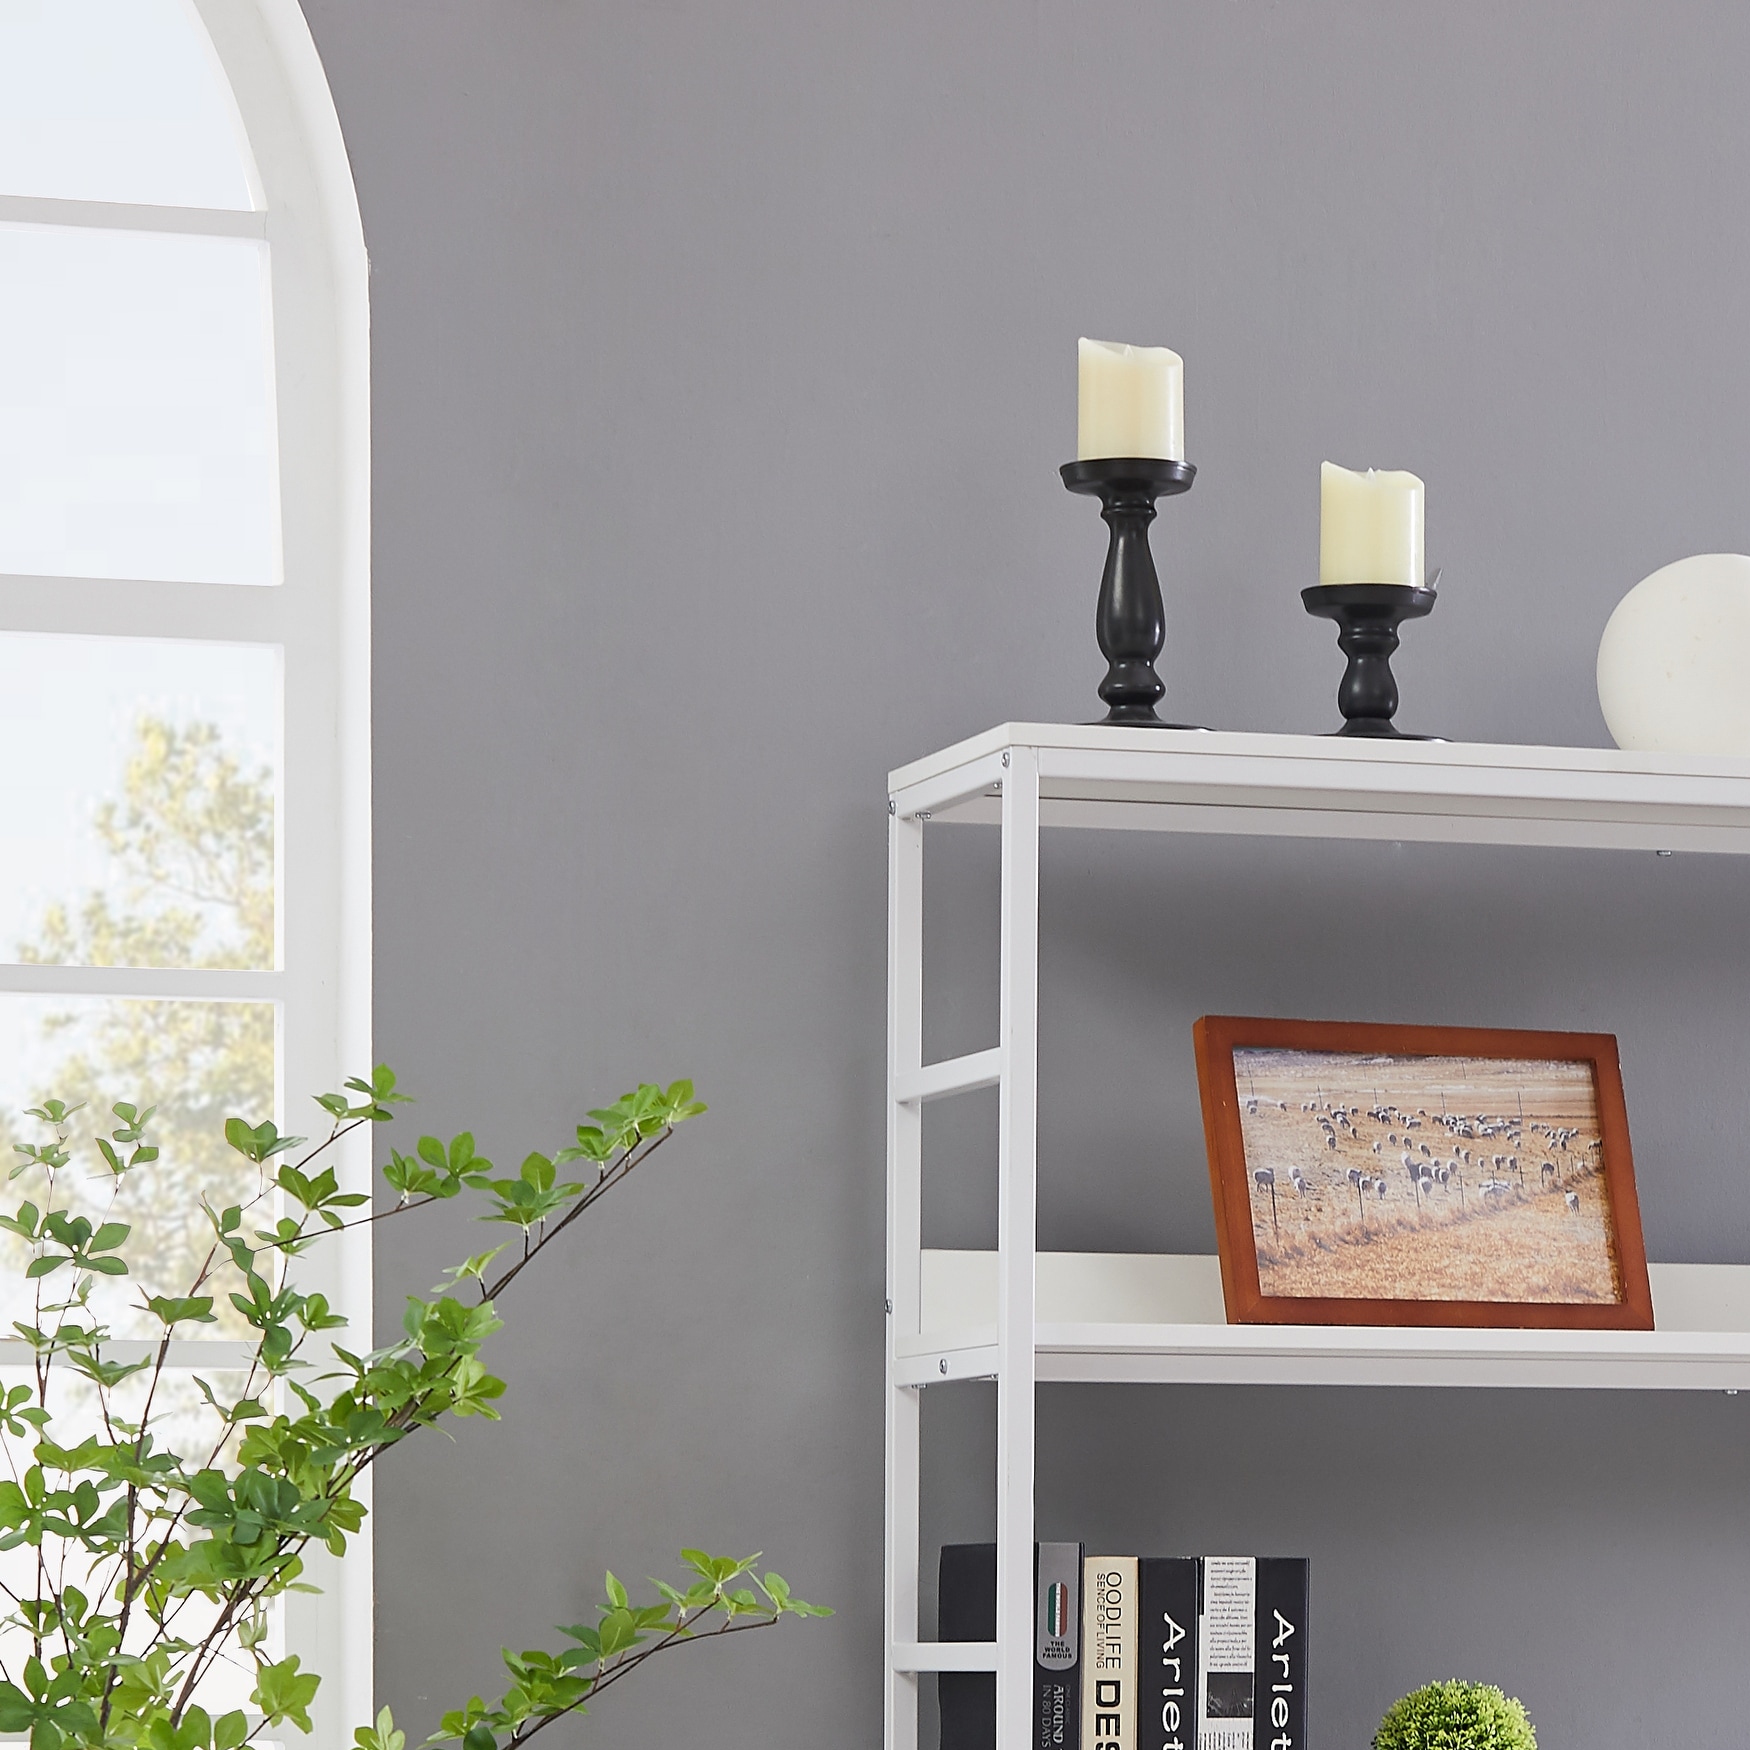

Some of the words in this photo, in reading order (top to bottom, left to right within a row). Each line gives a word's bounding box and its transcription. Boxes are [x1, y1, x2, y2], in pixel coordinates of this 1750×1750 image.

[1096, 1573, 1106, 1612] SENCE
[1096, 1614, 1105, 1627] OF
[1105, 1571, 1122, 1669] OODLIFE
[1095, 1632, 1105, 1669] LIVING
[1043, 1685, 1052, 1697] IN
[1042, 1701, 1051, 1715] 80
[1052, 1684, 1064, 1744] AROUND
[1041, 1718, 1051, 1748] DAYS
